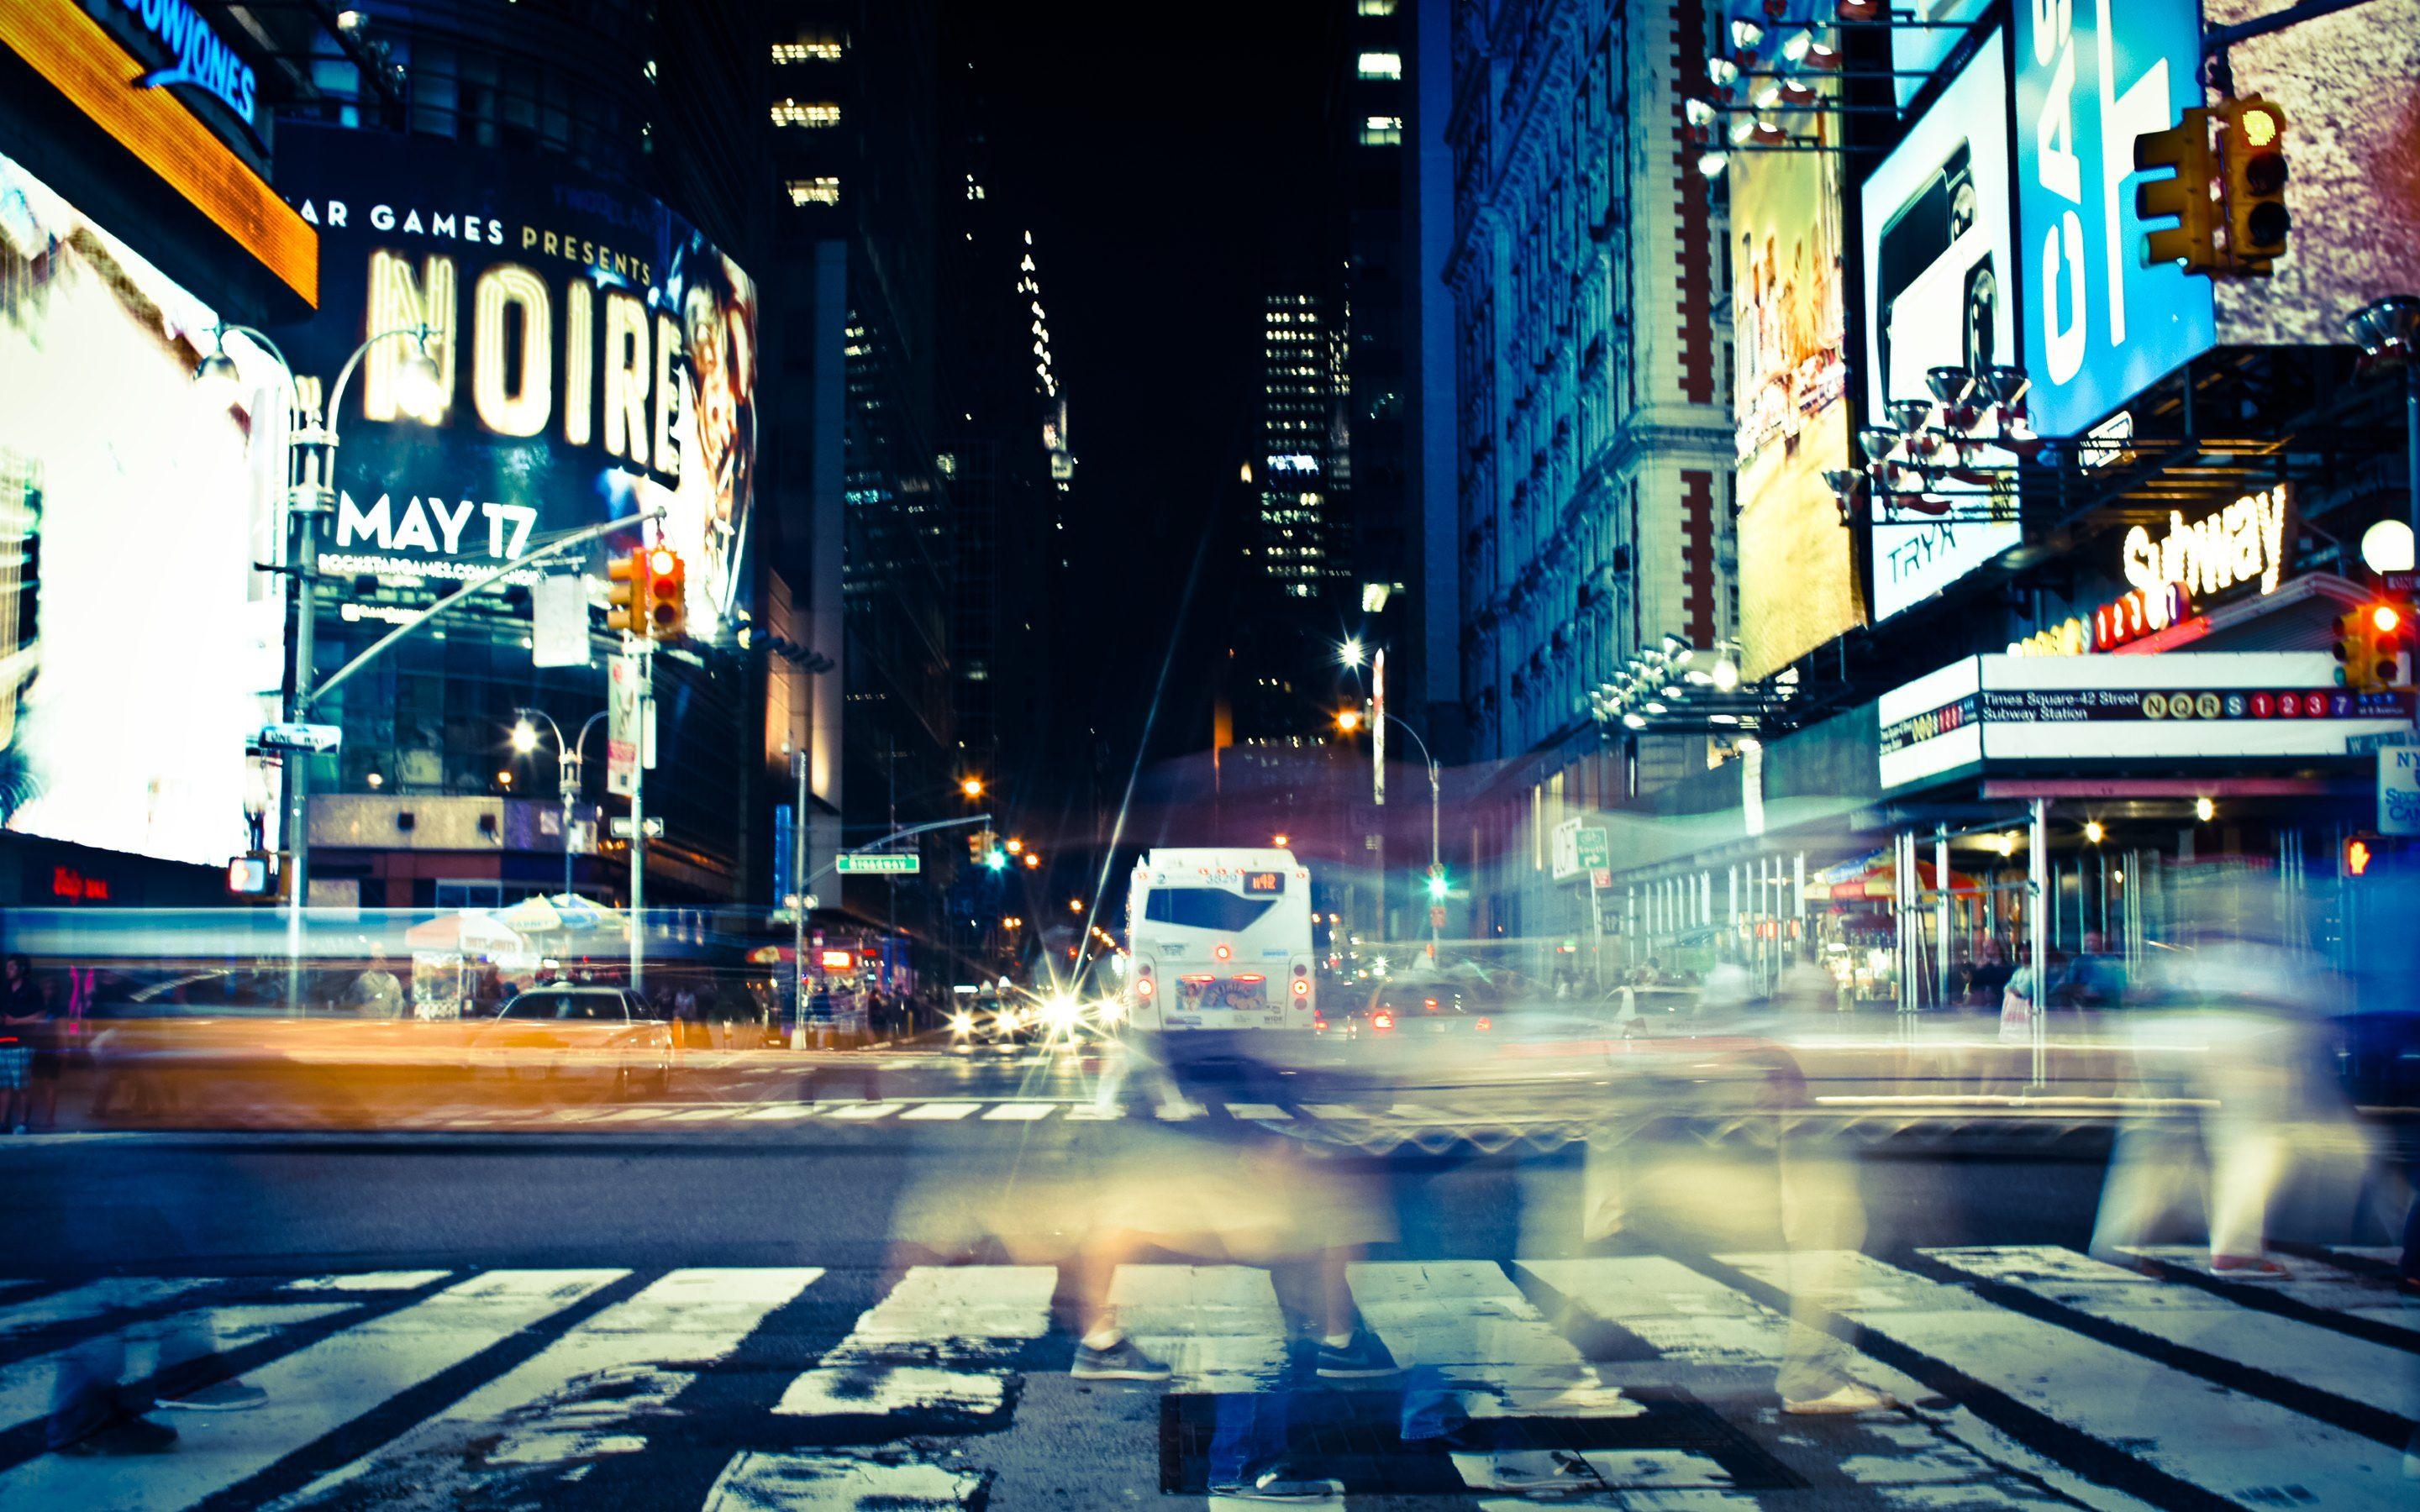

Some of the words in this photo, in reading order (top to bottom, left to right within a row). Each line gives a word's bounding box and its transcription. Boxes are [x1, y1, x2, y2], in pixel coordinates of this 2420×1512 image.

[285, 196, 348, 227] AR
[370, 204, 504, 245] GAMES
[522, 225, 652, 287] PRESENTS
[365, 249, 680, 478] NOIRE
[336, 490, 475, 554] MAY
[481, 501, 538, 560] 17
[1887, 522, 1956, 584] TRYX
[2123, 483, 2286, 596] Subway
[1981, 691, 2023, 706] Times
[2027, 690, 2096, 707] Square-42
[2099, 690, 2140, 706] Street
[1982, 706, 2036, 722] Subway
[2040, 706, 2089, 722] Station
